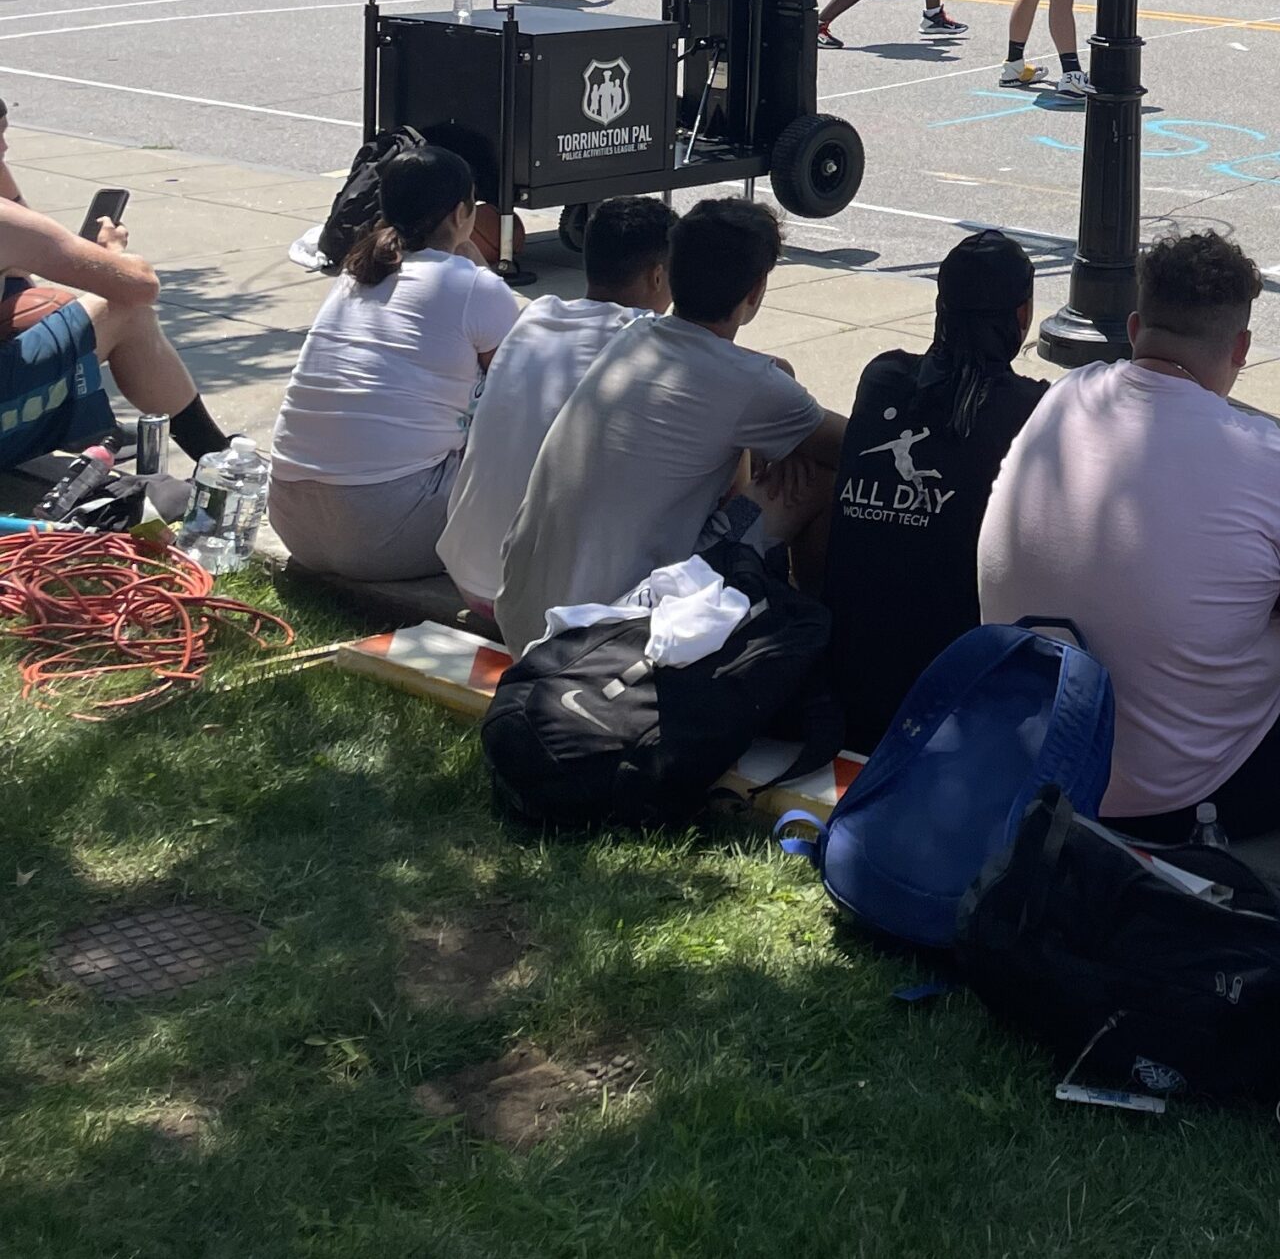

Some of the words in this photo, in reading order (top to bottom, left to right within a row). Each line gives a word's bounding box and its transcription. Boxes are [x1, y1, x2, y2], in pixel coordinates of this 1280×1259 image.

[557, 126, 629, 153] TORRINGTON
[631, 124, 653, 143] PAL
[561, 153, 582, 161] POLICE
[583, 147, 613, 158] ACTIVITIES
[839, 477, 884, 507] ALL
[893, 484, 956, 514] DAY
[842, 504, 895, 523] WOLCOTT
[898, 512, 930, 528] TECH
